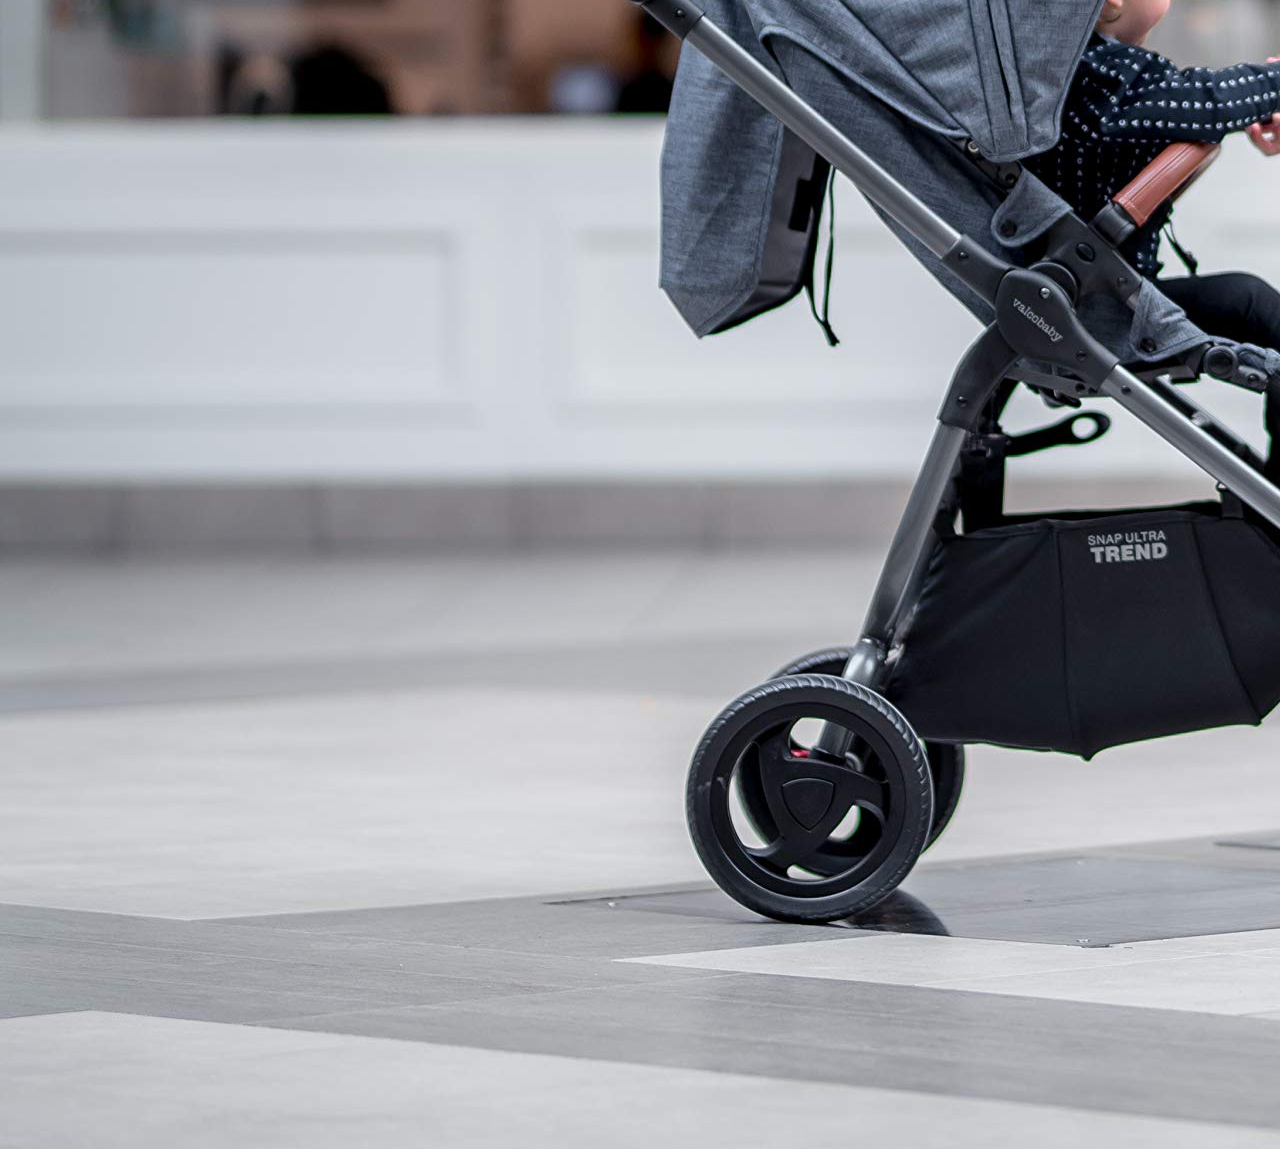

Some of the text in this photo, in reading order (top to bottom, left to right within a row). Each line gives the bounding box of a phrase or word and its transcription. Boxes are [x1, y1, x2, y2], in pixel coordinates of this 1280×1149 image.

[1013, 298, 1063, 342] valcobaby
[1087, 530, 1167, 546] SNAP ULTRA
[1090, 542, 1168, 564] TREND
